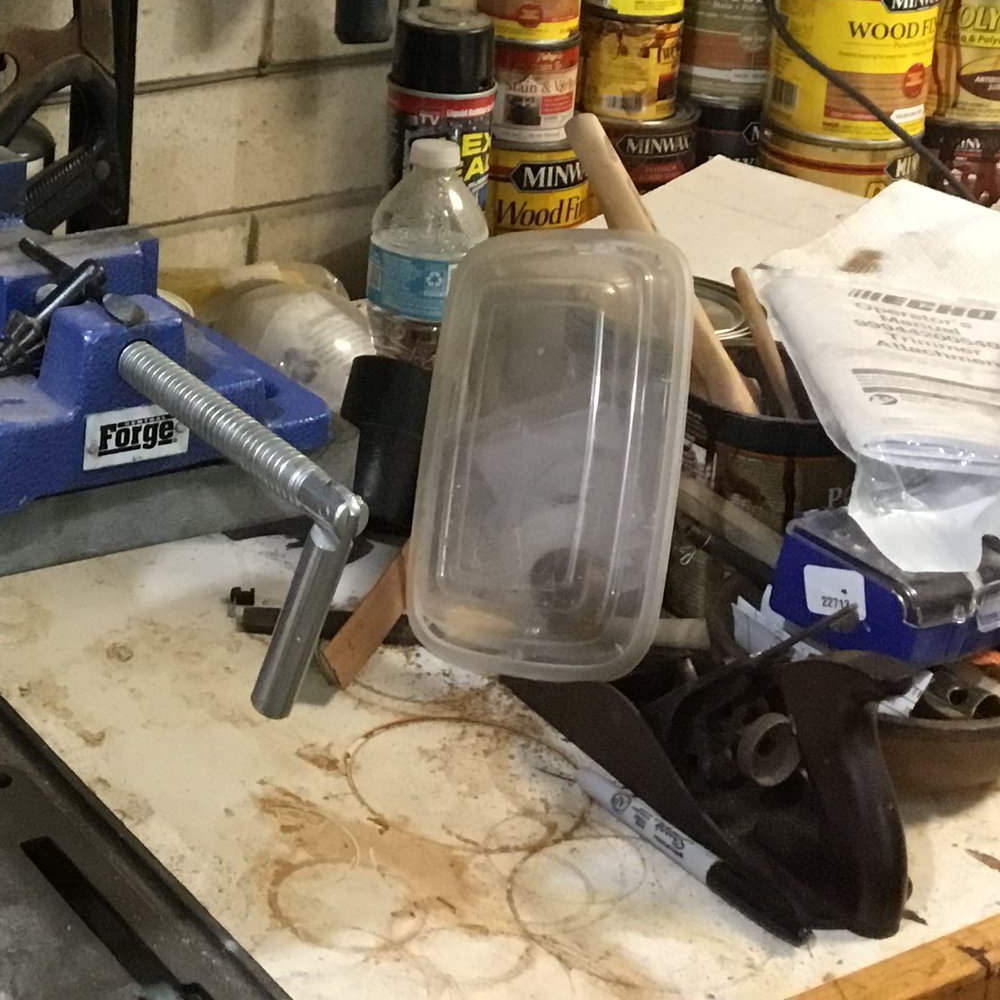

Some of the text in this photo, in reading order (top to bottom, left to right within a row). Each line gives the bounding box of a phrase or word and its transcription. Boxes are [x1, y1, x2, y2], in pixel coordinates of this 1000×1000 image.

[848, 21, 919, 40] WOOD
[504, 80, 538, 93] Stain
[541, 80, 551, 93] &
[420, 113, 440, 126] TV
[626, 135, 690, 155] MINWAX
[496, 199, 564, 226] Wood
[879, 314, 961, 335] Manual
[99, 420, 174, 450] Forge
